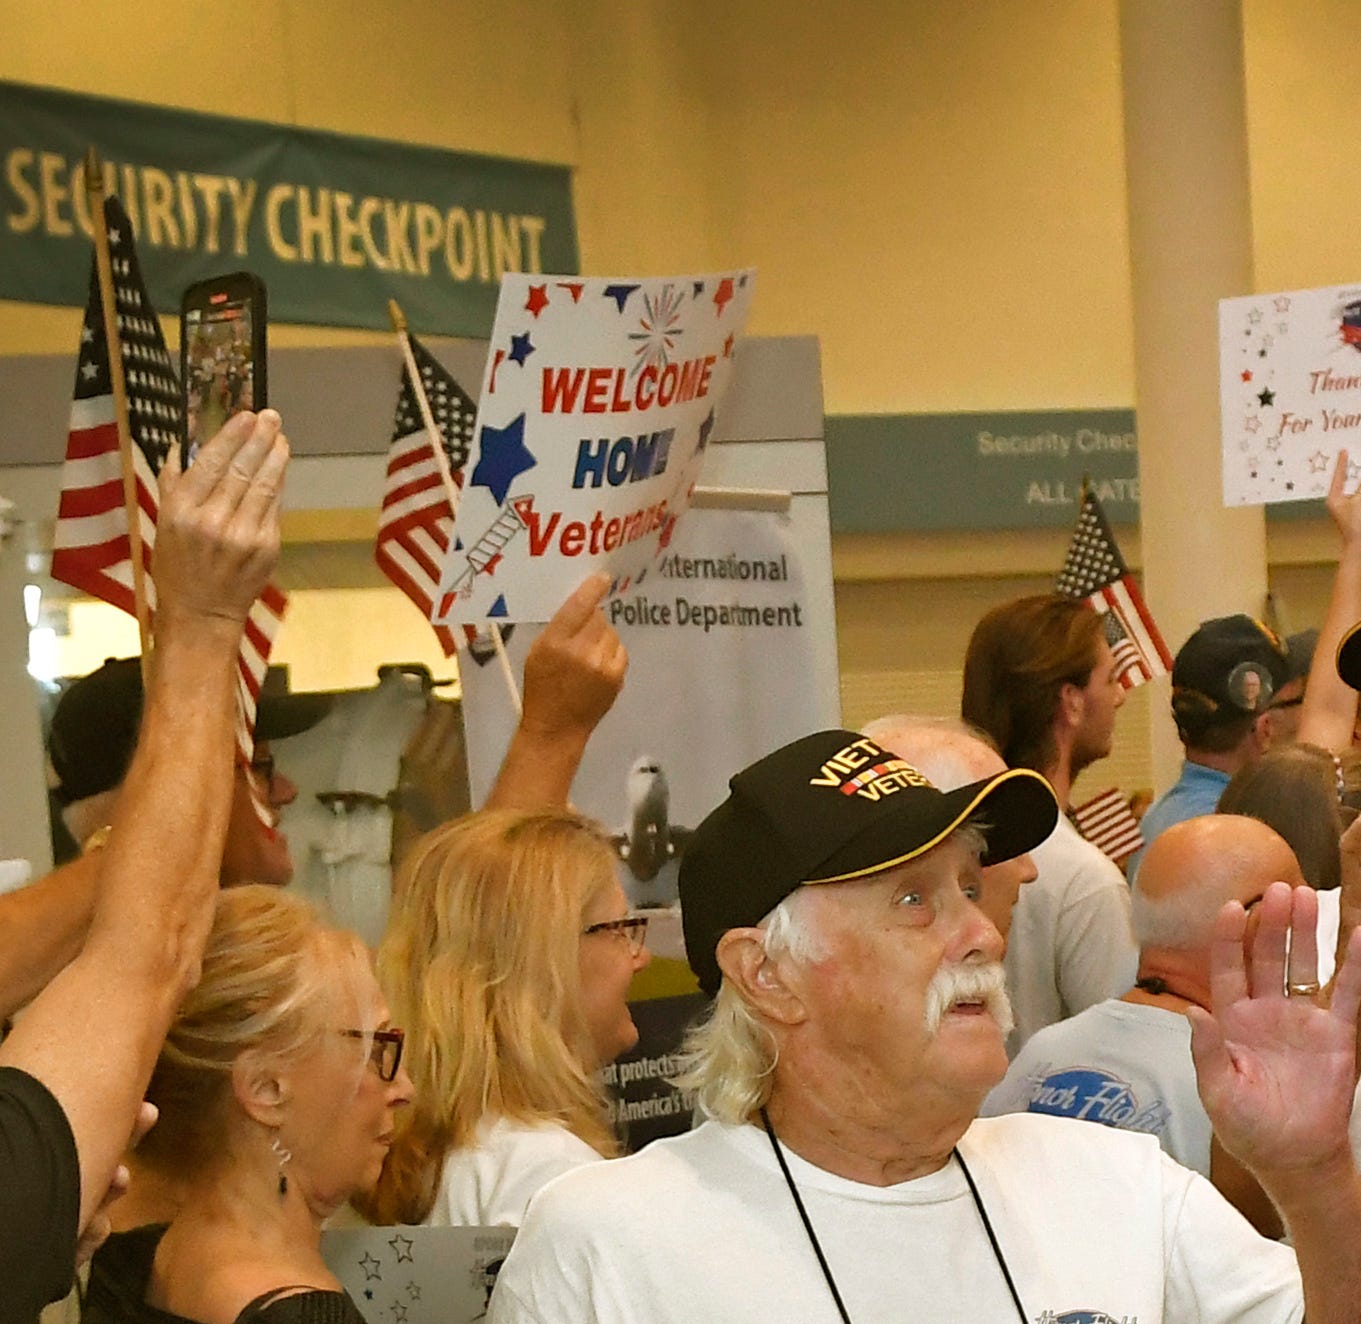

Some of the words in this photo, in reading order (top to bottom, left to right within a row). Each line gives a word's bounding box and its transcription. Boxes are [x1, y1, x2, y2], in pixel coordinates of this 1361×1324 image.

[6, 146, 257, 257] SECURITY
[266, 182, 547, 283] CHECKPOINT
[541, 355, 717, 414] WELCOME
[1278, 412, 1313, 437] For
[978, 430, 1072, 458] Security
[1075, 427, 1138, 453] Chec
[1027, 479, 1071, 504] ALL
[1087, 476, 1141, 502] ATE
[527, 499, 668, 557] Veterans
[663, 552, 789, 582] ternational
[611, 598, 672, 627] Police
[676, 598, 803, 633] Department
[809, 738, 883, 788] VIET
[856, 767, 932, 802] VETE
[619, 1053, 674, 1089] protects
[618, 1091, 683, 1122] America's
